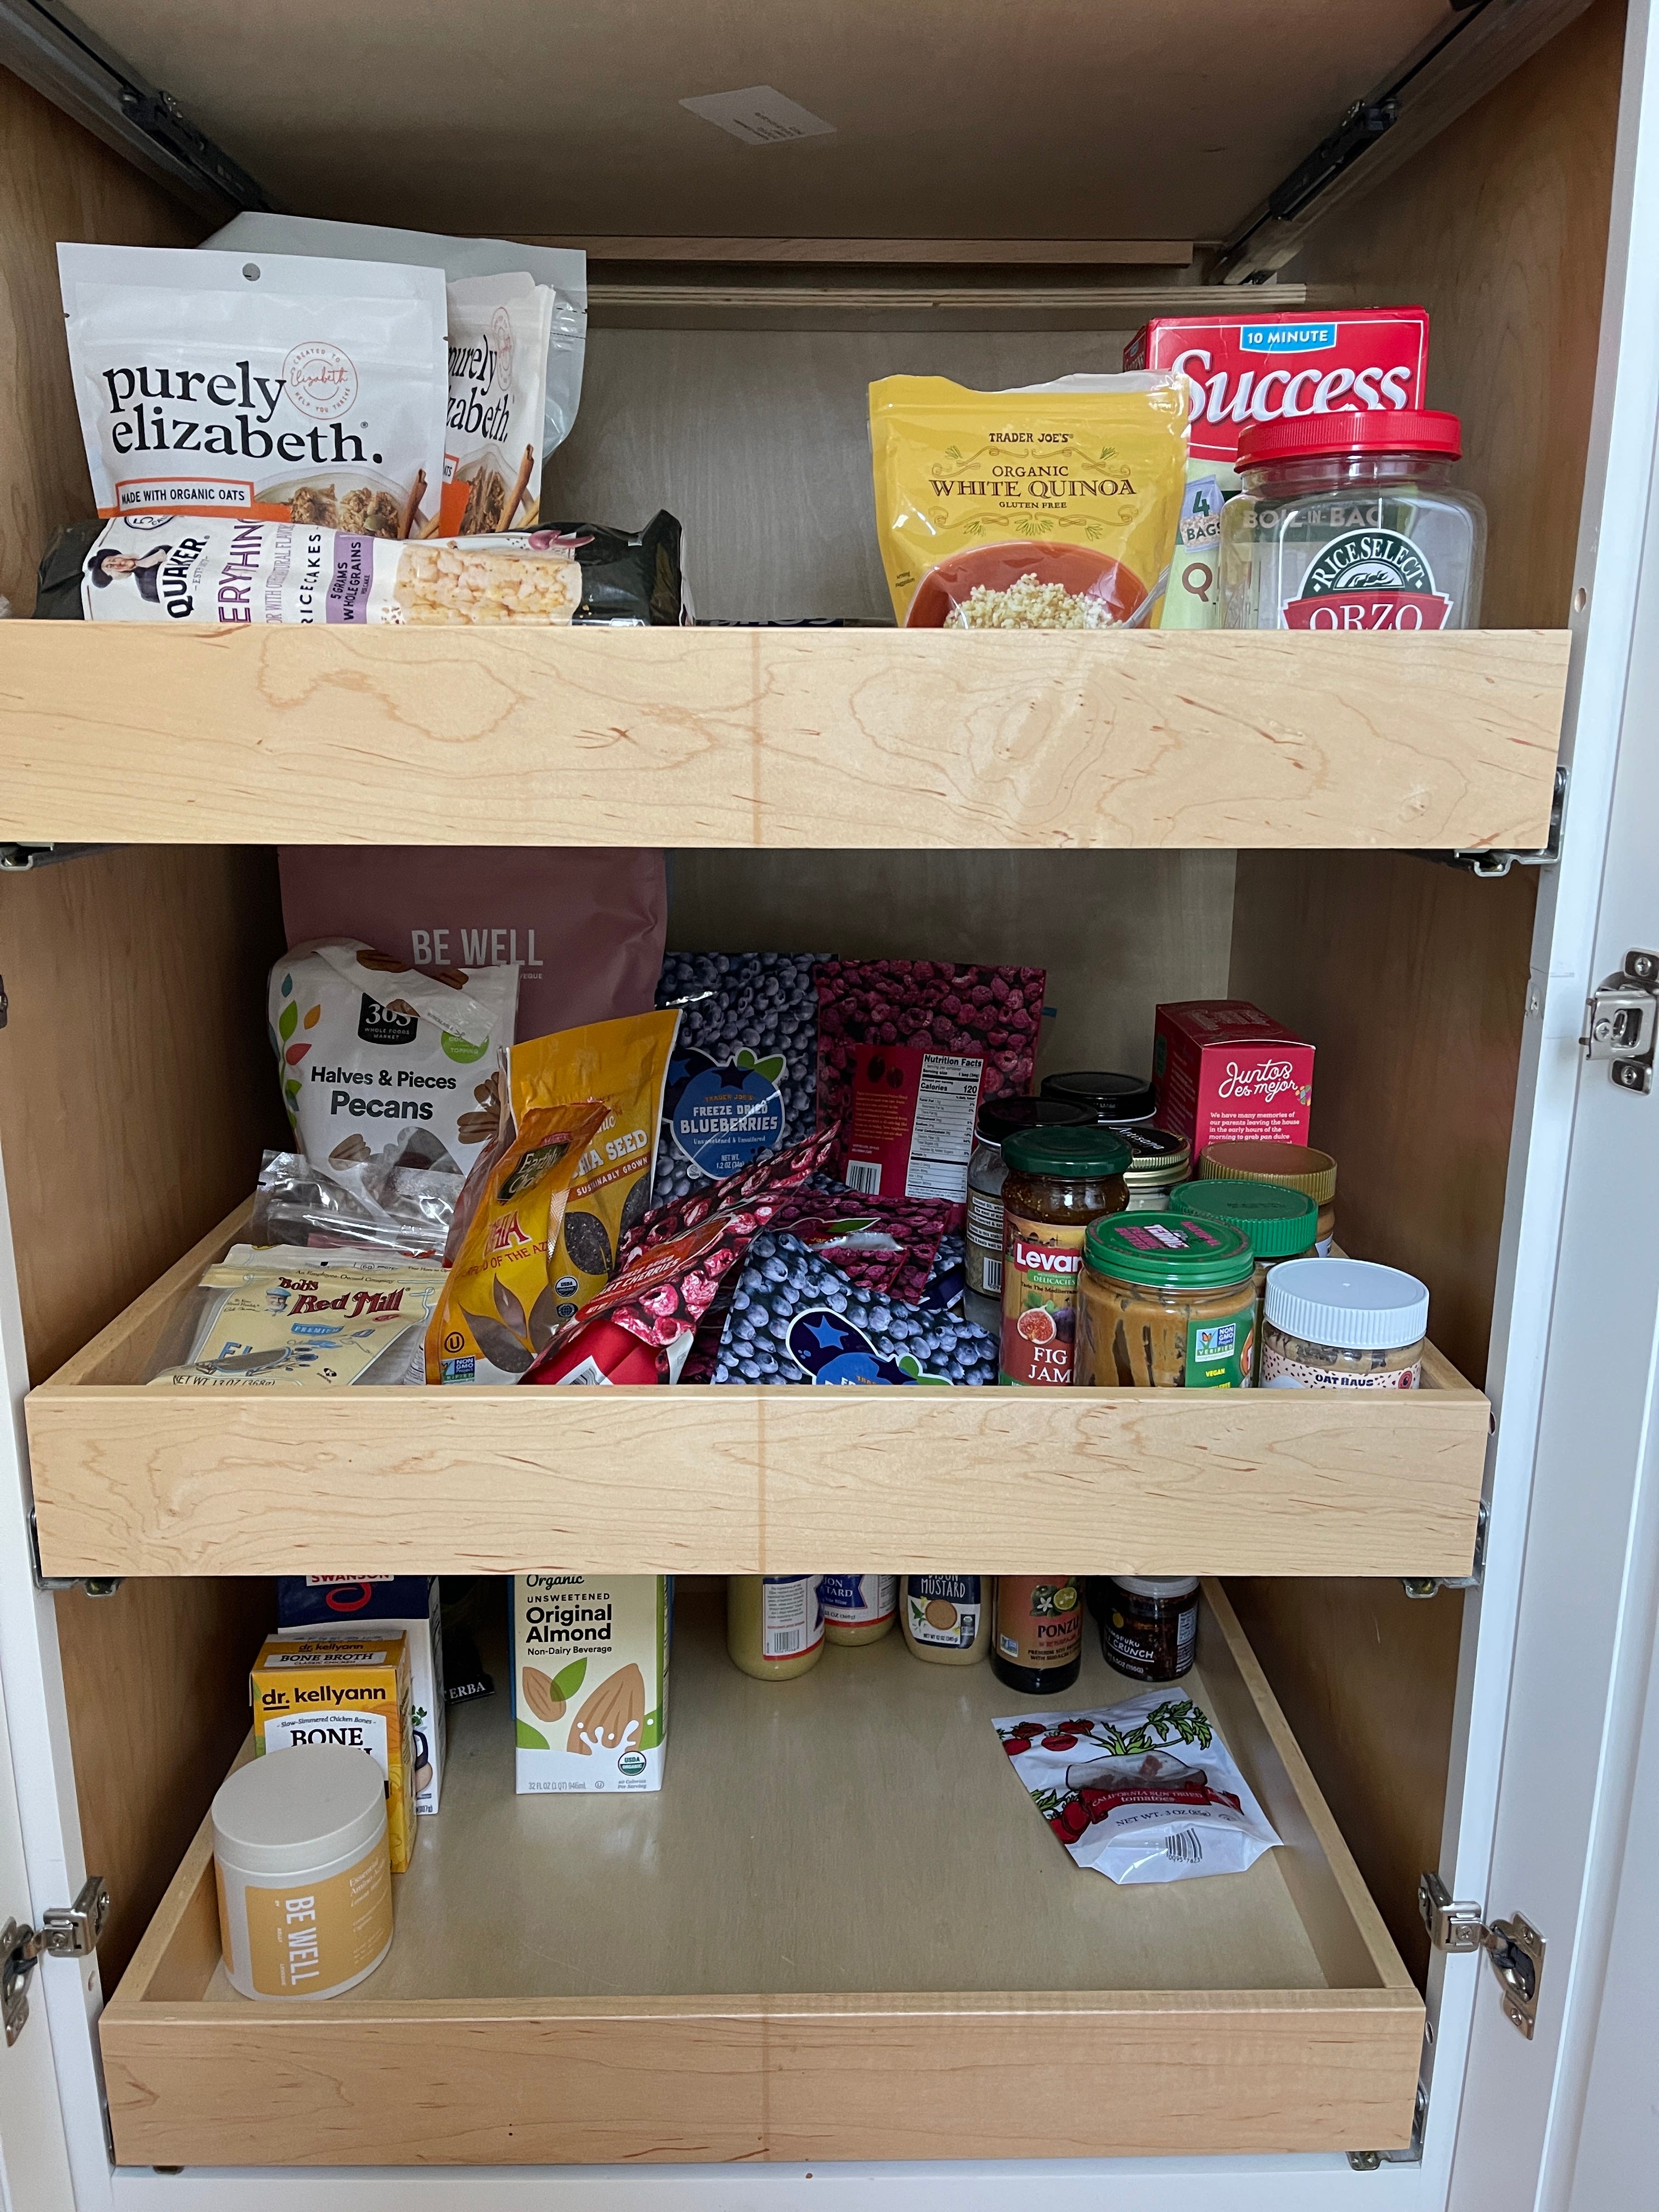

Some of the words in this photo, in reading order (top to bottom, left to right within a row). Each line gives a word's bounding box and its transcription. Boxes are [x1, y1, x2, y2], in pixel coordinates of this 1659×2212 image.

[1248, 332, 1265, 344] 10
[1268, 330, 1328, 343] MINUTE
[294, 348, 326, 364] CREATED
[331, 354, 341, 363] TO
[290, 366, 348, 387] Elizabeth
[103, 360, 287, 422] purely
[1172, 349, 1412, 424] Success
[295, 392, 311, 406] HELP
[332, 387, 351, 410] THRIVE
[111, 403, 383, 464] elizabeth.
[988, 433, 1034, 443] TRADER
[992, 465, 1069, 477] ORGANIC
[121, 490, 142, 505] MADE
[143, 488, 167, 503] WITH
[170, 487, 215, 501] ORGANIC
[219, 489, 245, 502] OATS
[928, 479, 1022, 497] WHITE
[1028, 478, 1137, 499] QUINOA
[998, 501, 1040, 509] GLUTEN
[1042, 501, 1067, 509] FREE
[1193, 490, 1210, 517] 4
[303, 534, 322, 583] CAKES
[347, 541, 362, 586] GRAINS
[1318, 537, 1424, 585] RICESELECT
[161, 537, 207, 619] QUAKER
[331, 562, 347, 593] GRAMS
[266, 591, 282, 611] WITH
[343, 587, 358, 620] WHOLE
[1309, 603, 1423, 629] ORZO
[411, 929, 451, 965] BE
[460, 928, 544, 966] WELL
[924, 1054, 959, 1065] Nutrition
[961, 1058, 982, 1067] Facts
[311, 1065, 373, 1086] Halves
[377, 1069, 393, 1086] &
[397, 1070, 457, 1090] Pieces
[1218, 1059, 1294, 1098] Juntos
[921, 1082, 948, 1092] Calories
[963, 1085, 978, 1094] 120
[1234, 1085, 1252, 1097] es
[1253, 1078, 1299, 1103] mejor
[330, 1090, 434, 1121] Pecans
[705, 1094, 732, 1102] TRADER
[693, 1105, 732, 1117] FREEZE
[737, 1104, 768, 1115] DRIED
[680, 1116, 778, 1135] BLUEBERRIES
[605, 1129, 648, 1161] SEED
[693, 1137, 731, 1145] Unsweetened
[622, 1156, 648, 1174] GROWN
[490, 1255, 503, 1268] OF
[504, 1248, 531, 1263] THE
[622, 1257, 682, 1287] CHERRIES
[1033, 1275, 1076, 1286] DELICACIES
[278, 1276, 319, 1291] Bob's
[286, 1291, 351, 1317] Red
[343, 1287, 405, 1318] Mill
[1218, 1332, 1234, 1341] GMO
[1219, 1326, 1234, 1335] NON
[1033, 1346, 1068, 1365] FIG
[1199, 1345, 1233, 1356] VERIFIED
[173, 1375, 193, 1385] NET
[193, 1376, 211, 1385] WT
[1028, 1364, 1073, 1383] JAM
[1205, 1368, 1226, 1378] VEGAN
[1315, 1374, 1339, 1385] OAT
[1340, 1378, 1374, 1387] HAUS
[526, 1575, 585, 1590] Organic
[921, 1578, 966, 1598] MUSTARD
[527, 1593, 610, 1603] UNSWEETENED
[526, 1604, 612, 1627] Original
[526, 1622, 611, 1644] Almond
[1037, 1615, 1080, 1638] PONZU
[315, 1643, 364, 1651] kellyann
[527, 1646, 571, 1656] Non-Dairy
[573, 1645, 612, 1654] Beverage
[1113, 1638, 1154, 1659] CRUNCH
[280, 1654, 321, 1662] BONE
[322, 1653, 374, 1661] BROTH
[262, 1689, 290, 1706] dr.
[294, 1685, 386, 1706] kellyann
[281, 1716, 329, 1728] Slow-Simmered
[354, 1717, 373, 1725] Bones
[290, 1728, 363, 1747] BONE
[1092, 1790, 1148, 1807] CALIFORNIA
[1172, 1791, 1203, 1799] DRIED
[1115, 1815, 1139, 1827] NET
[1140, 1812, 1163, 1821] WT.
[285, 1895, 316, 1925] BE
[287, 1926, 320, 1985] WELL
